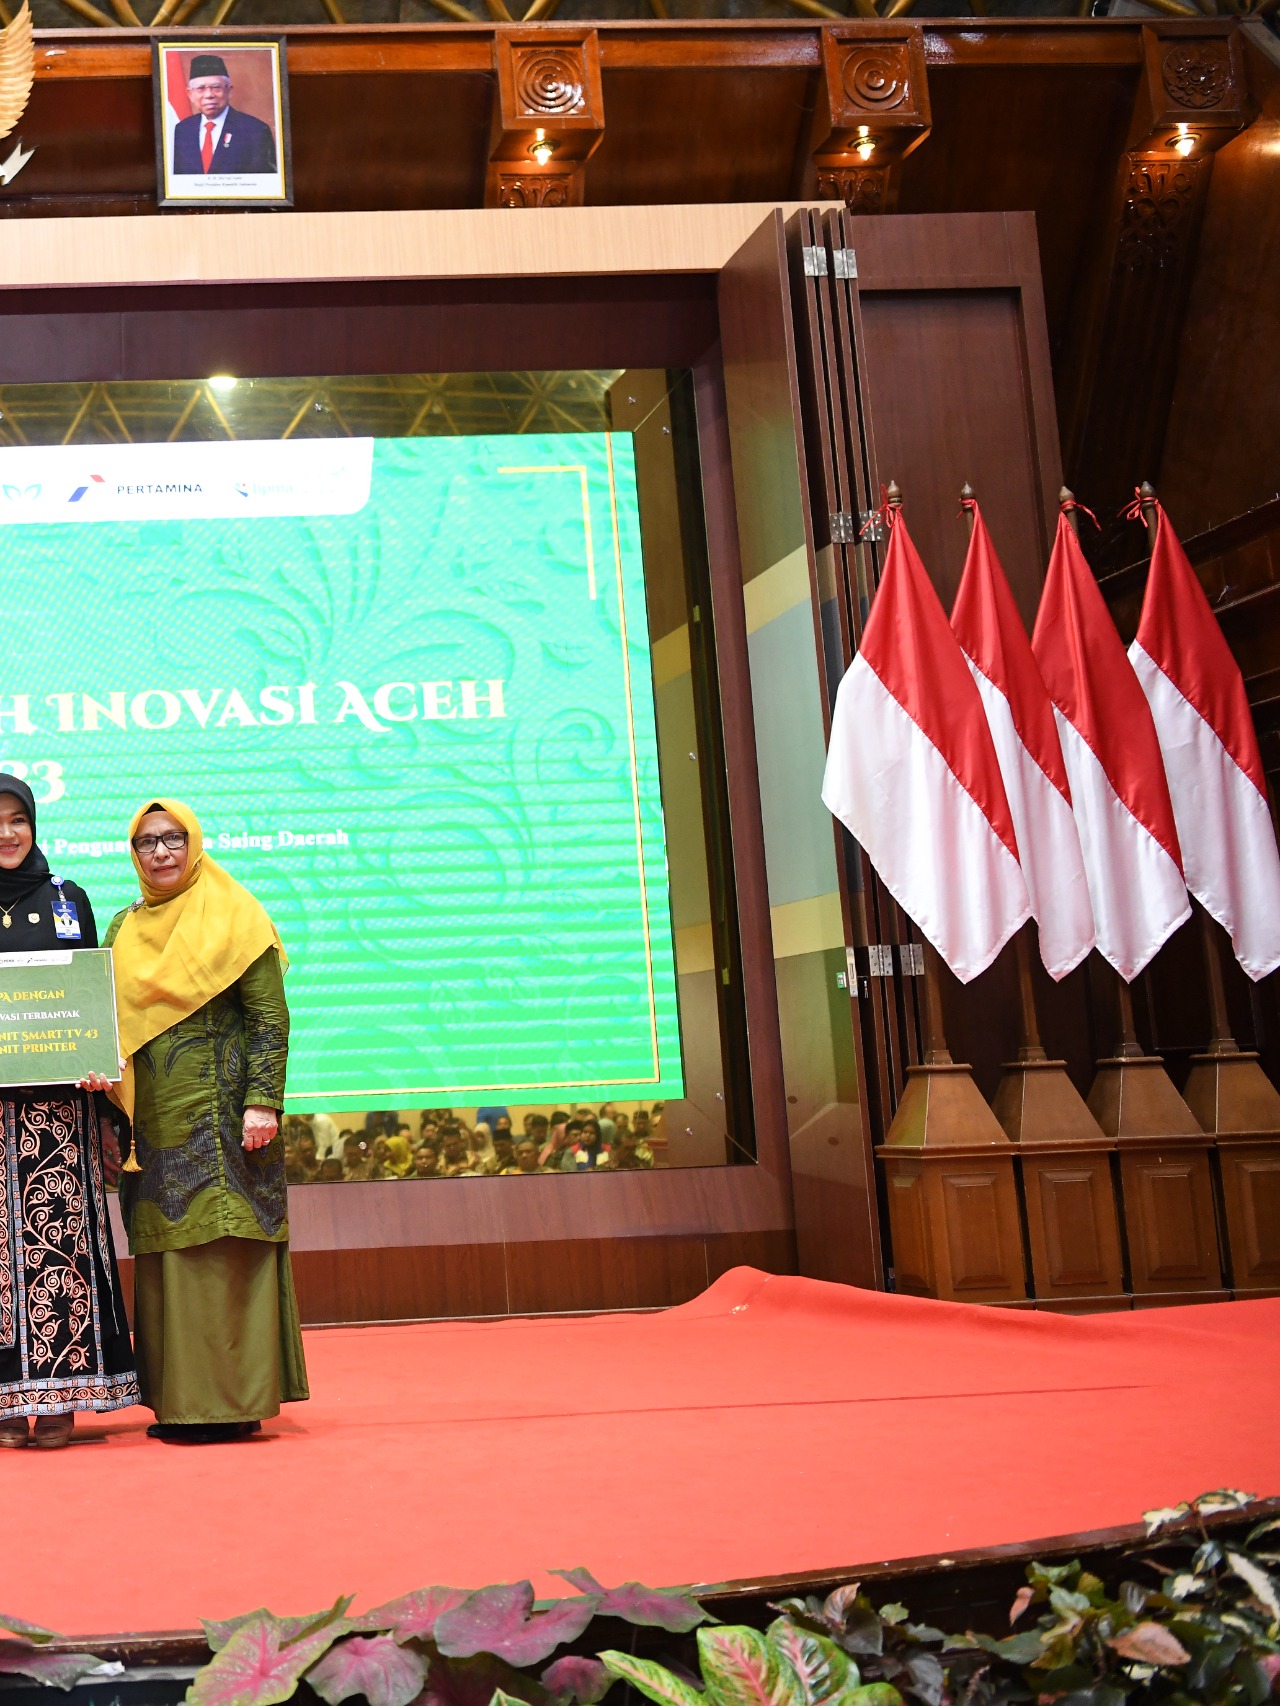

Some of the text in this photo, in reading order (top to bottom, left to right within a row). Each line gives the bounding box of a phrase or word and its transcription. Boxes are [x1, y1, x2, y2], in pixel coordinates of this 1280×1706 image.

[117, 484, 203, 495] PERTAMINA
[45, 681, 319, 732] INOVASI
[333, 679, 507, 733] ACEH
[218, 832, 273, 851] Saing
[277, 829, 349, 847] Daerah
[13, 989, 64, 1002] DENGAN
[22, 1010, 80, 1020] TERBANYAK
[21, 1030, 64, 1041] SMART
[64, 1028, 83, 1039] TV
[22, 1042, 78, 1053] PRINTER
